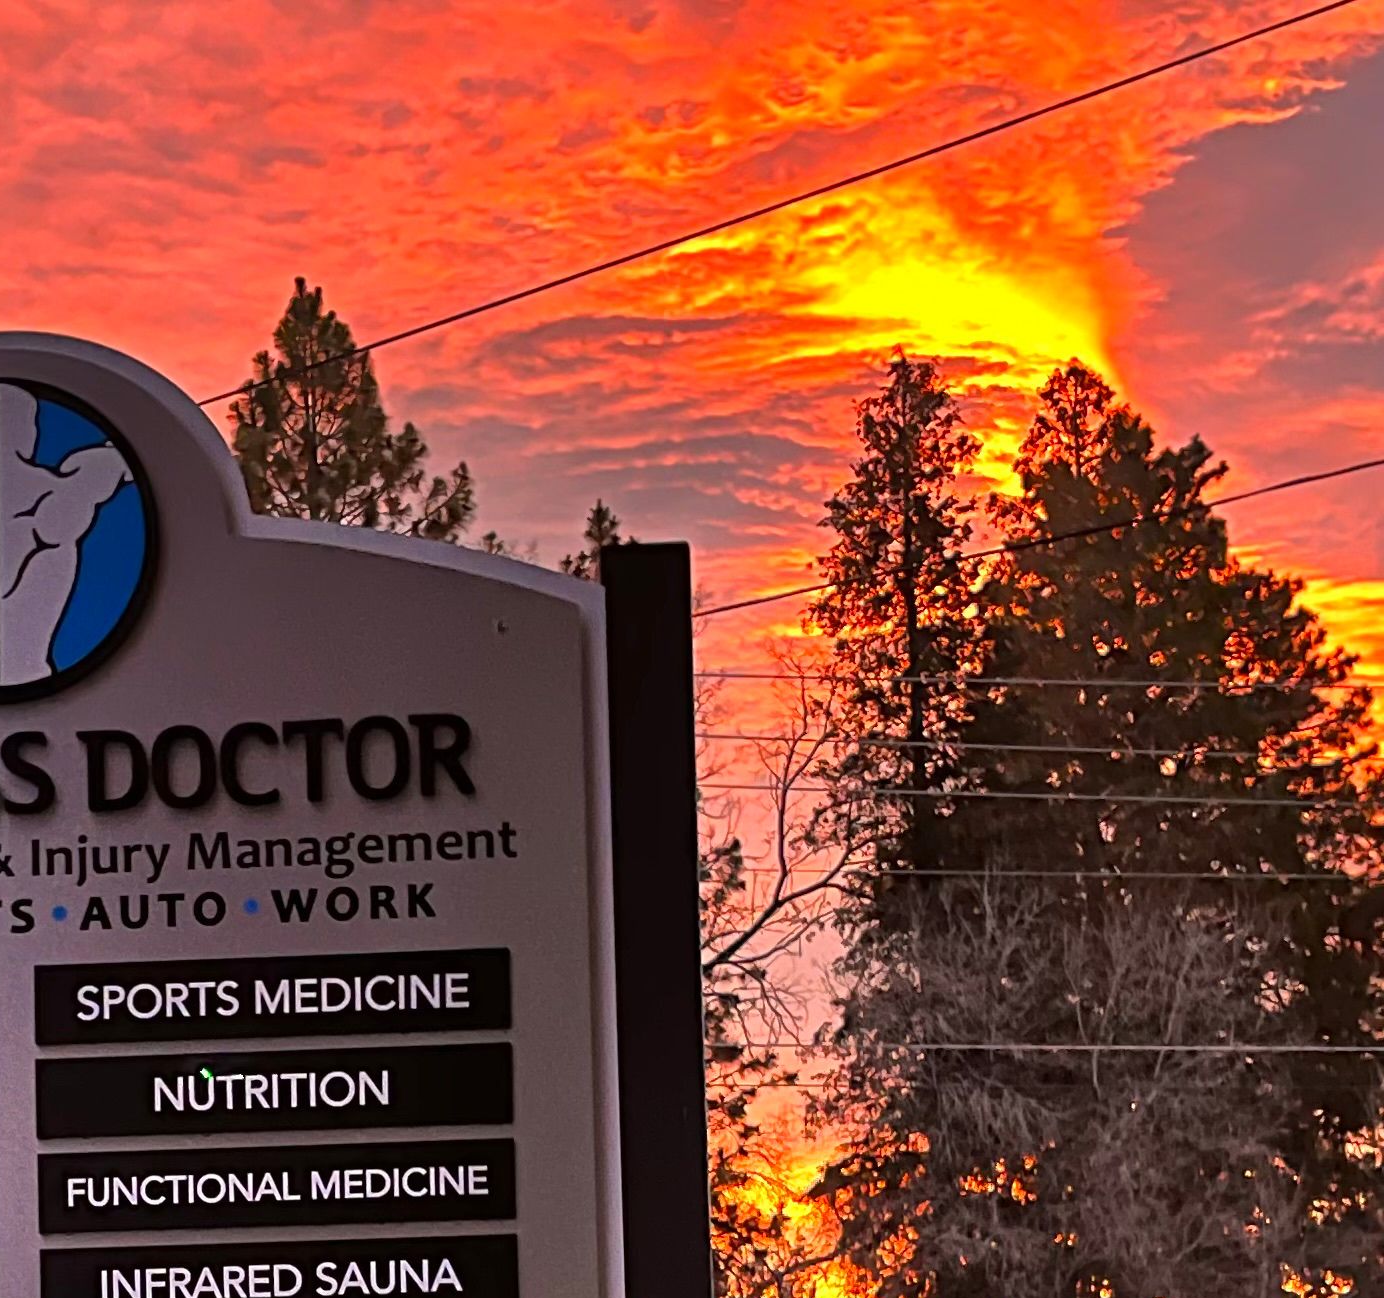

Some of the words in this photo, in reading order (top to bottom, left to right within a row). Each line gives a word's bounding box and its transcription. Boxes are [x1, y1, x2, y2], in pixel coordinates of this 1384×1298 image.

[76, 713, 476, 814] DOCTOR
[31, 835, 170, 887] Injury
[187, 822, 517, 879] Management
[79, 891, 227, 931] AUTO
[271, 883, 437, 923] WORK
[76, 980, 240, 1021] SPORTS
[254, 973, 470, 1015] MEDICINE
[153, 1071, 389, 1113] NUTRITION
[67, 1171, 301, 1208] FUNCTIONAL
[310, 1165, 489, 1201] MEDICINE
[315, 1258, 463, 1297] SAUNA
